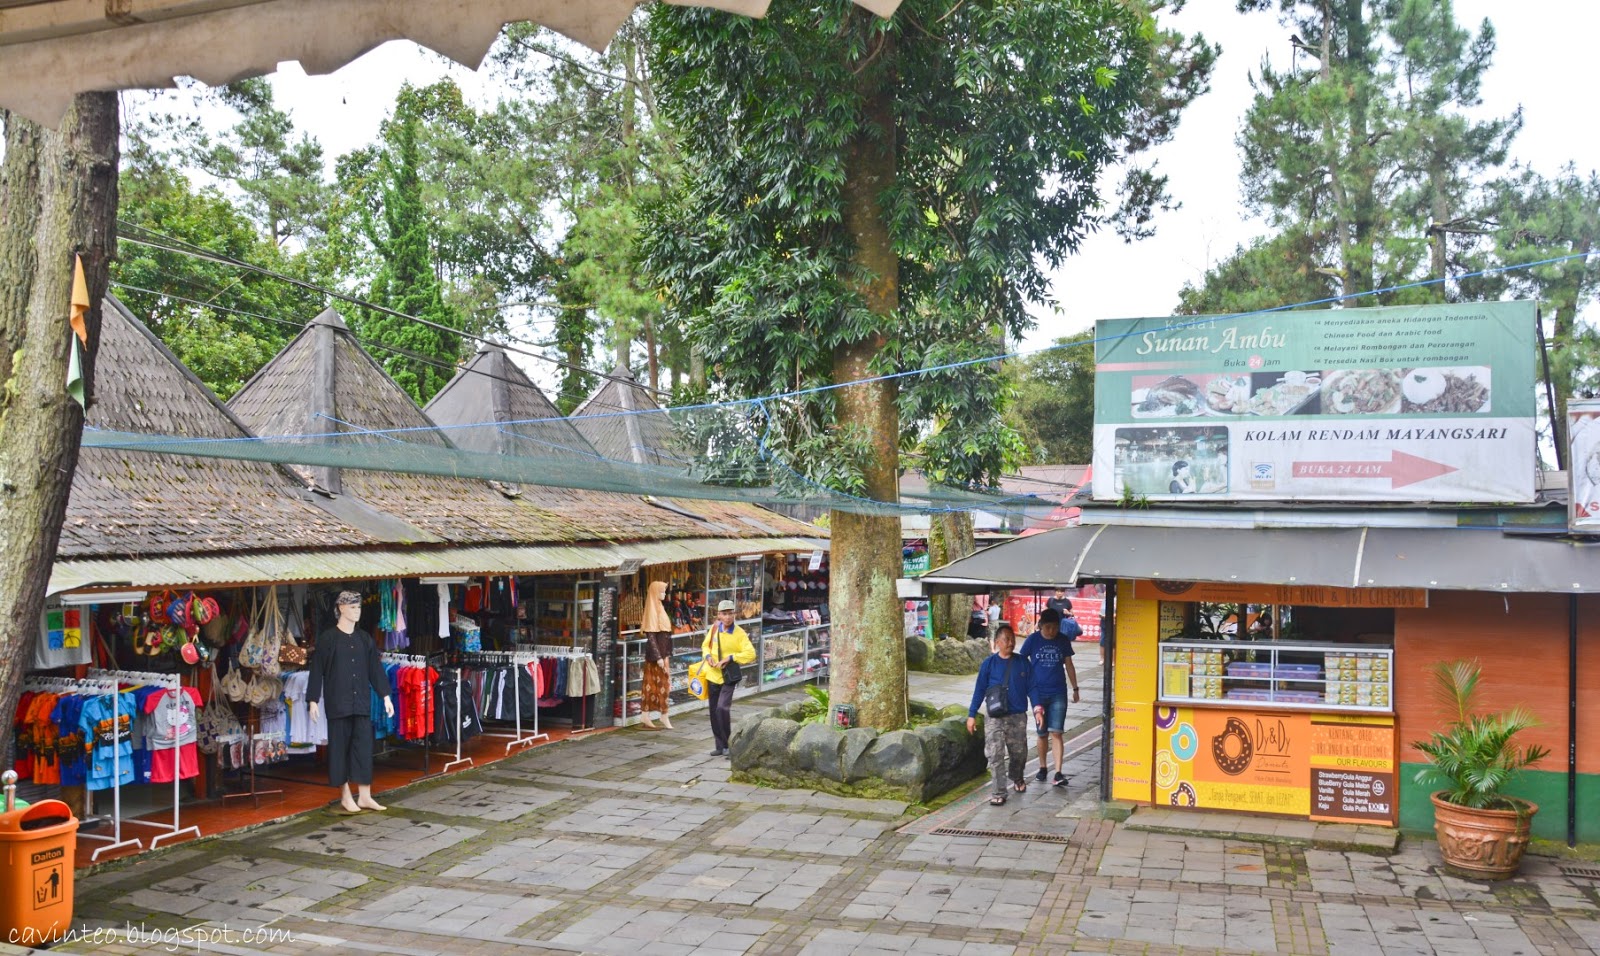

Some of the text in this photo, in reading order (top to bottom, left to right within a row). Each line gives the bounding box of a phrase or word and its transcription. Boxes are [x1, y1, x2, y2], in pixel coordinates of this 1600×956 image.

[1165, 318, 1217, 330] Kedai
[1324, 319, 1376, 328] Menyediakan
[1403, 315, 1442, 325] Hidangan
[1395, 329, 1422, 337] Arabic
[1136, 328, 1286, 355] Sunan Ambu
[1323, 344, 1359, 353] Melayani
[1360, 343, 1408, 351] Rombongan
[1427, 341, 1475, 350] Perorangan
[1223, 357, 1281, 369] Buka 24 jam
[1396, 355, 1420, 363] untuk
[1423, 354, 1469, 364] rombongan
[1244, 427, 1508, 442] KOLAM RENDAM MAYANGSARI
[1299, 464, 1382, 475] BUKA 24 JAM
[903, 563, 924, 571] HIJAB
[1336, 758, 1388, 768] OUR FLAVOURS
[1318, 794, 1335, 802] Durian
[1342, 796, 1355, 804] Gula
[1318, 802, 1330, 811] Keju
[33, 848, 63, 863] Dalton
